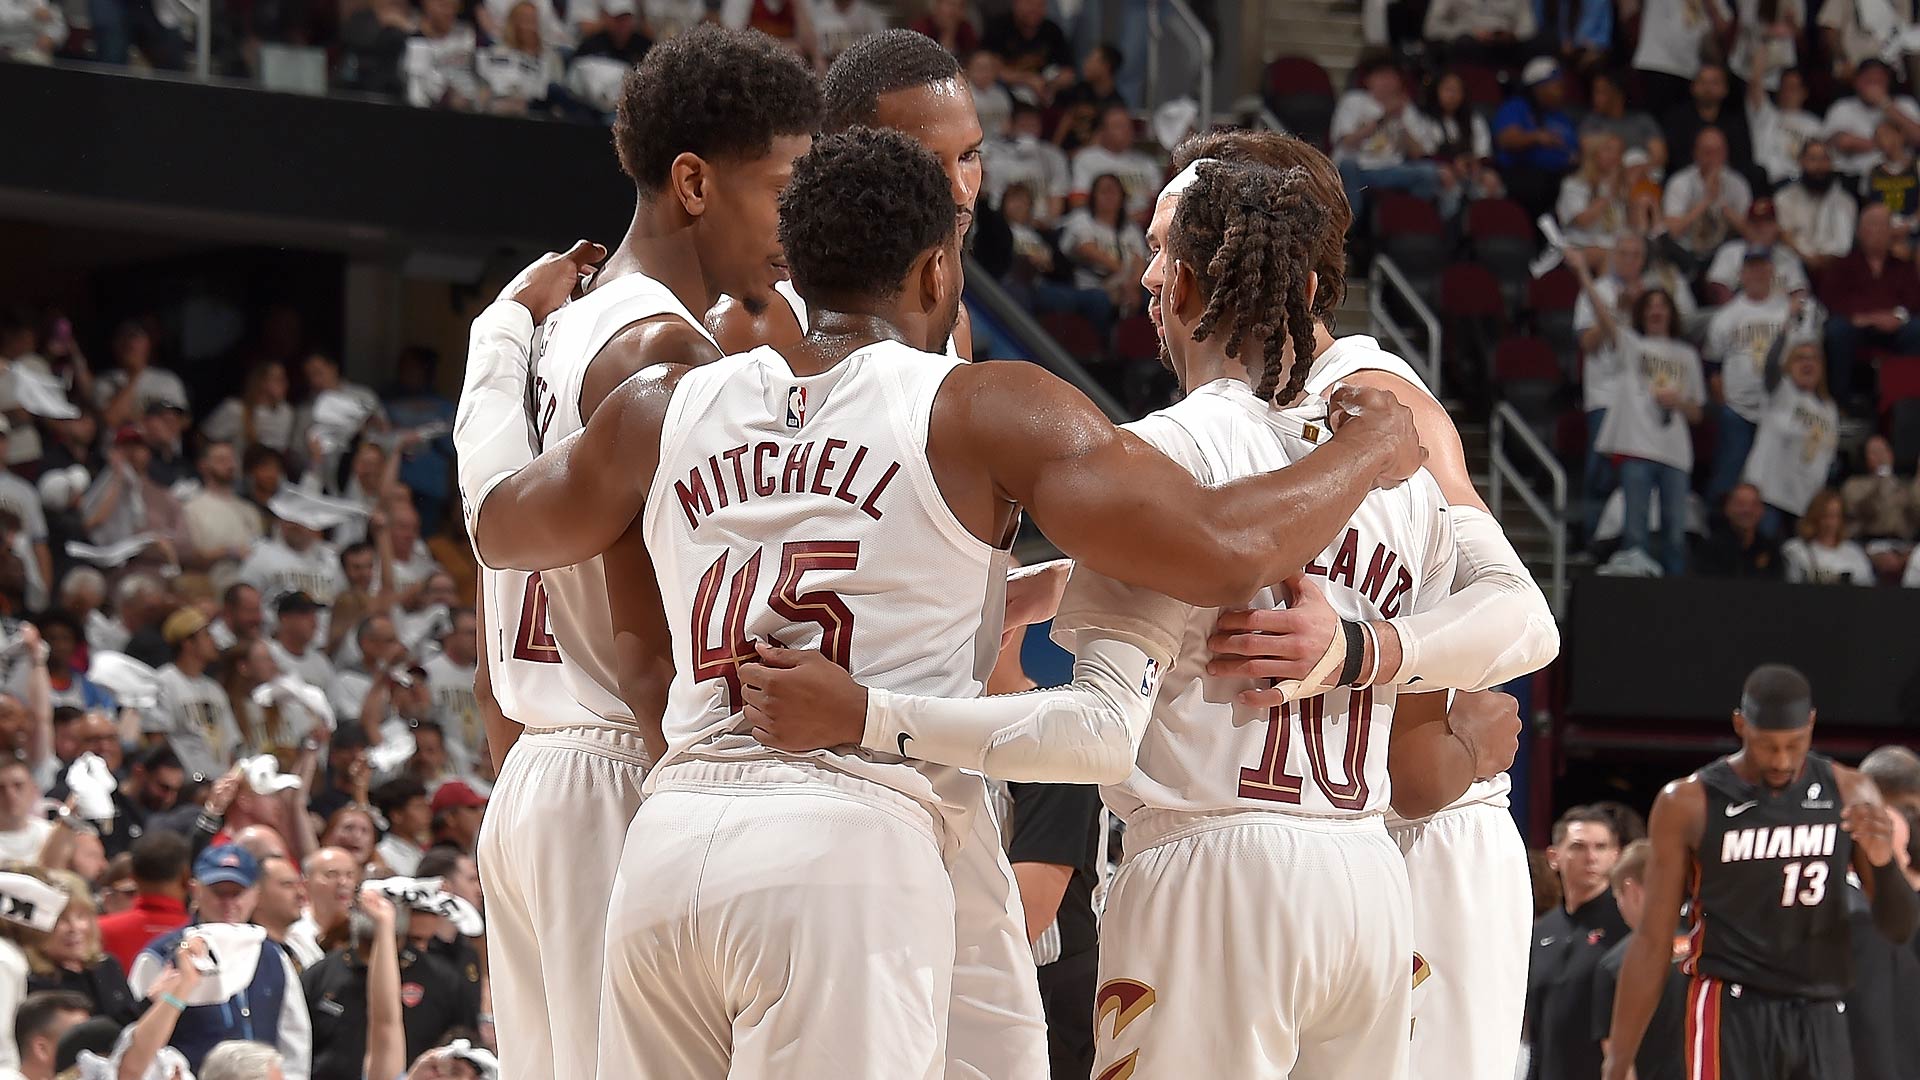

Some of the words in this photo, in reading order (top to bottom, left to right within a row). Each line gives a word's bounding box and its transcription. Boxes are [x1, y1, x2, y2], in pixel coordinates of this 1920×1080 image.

[674, 439, 901, 530] MITCHELL
[691, 540, 860, 716] 45
[1237, 677, 1369, 811] 10
[1721, 823, 1838, 864] MIAMI
[1781, 860, 1830, 908] 13
